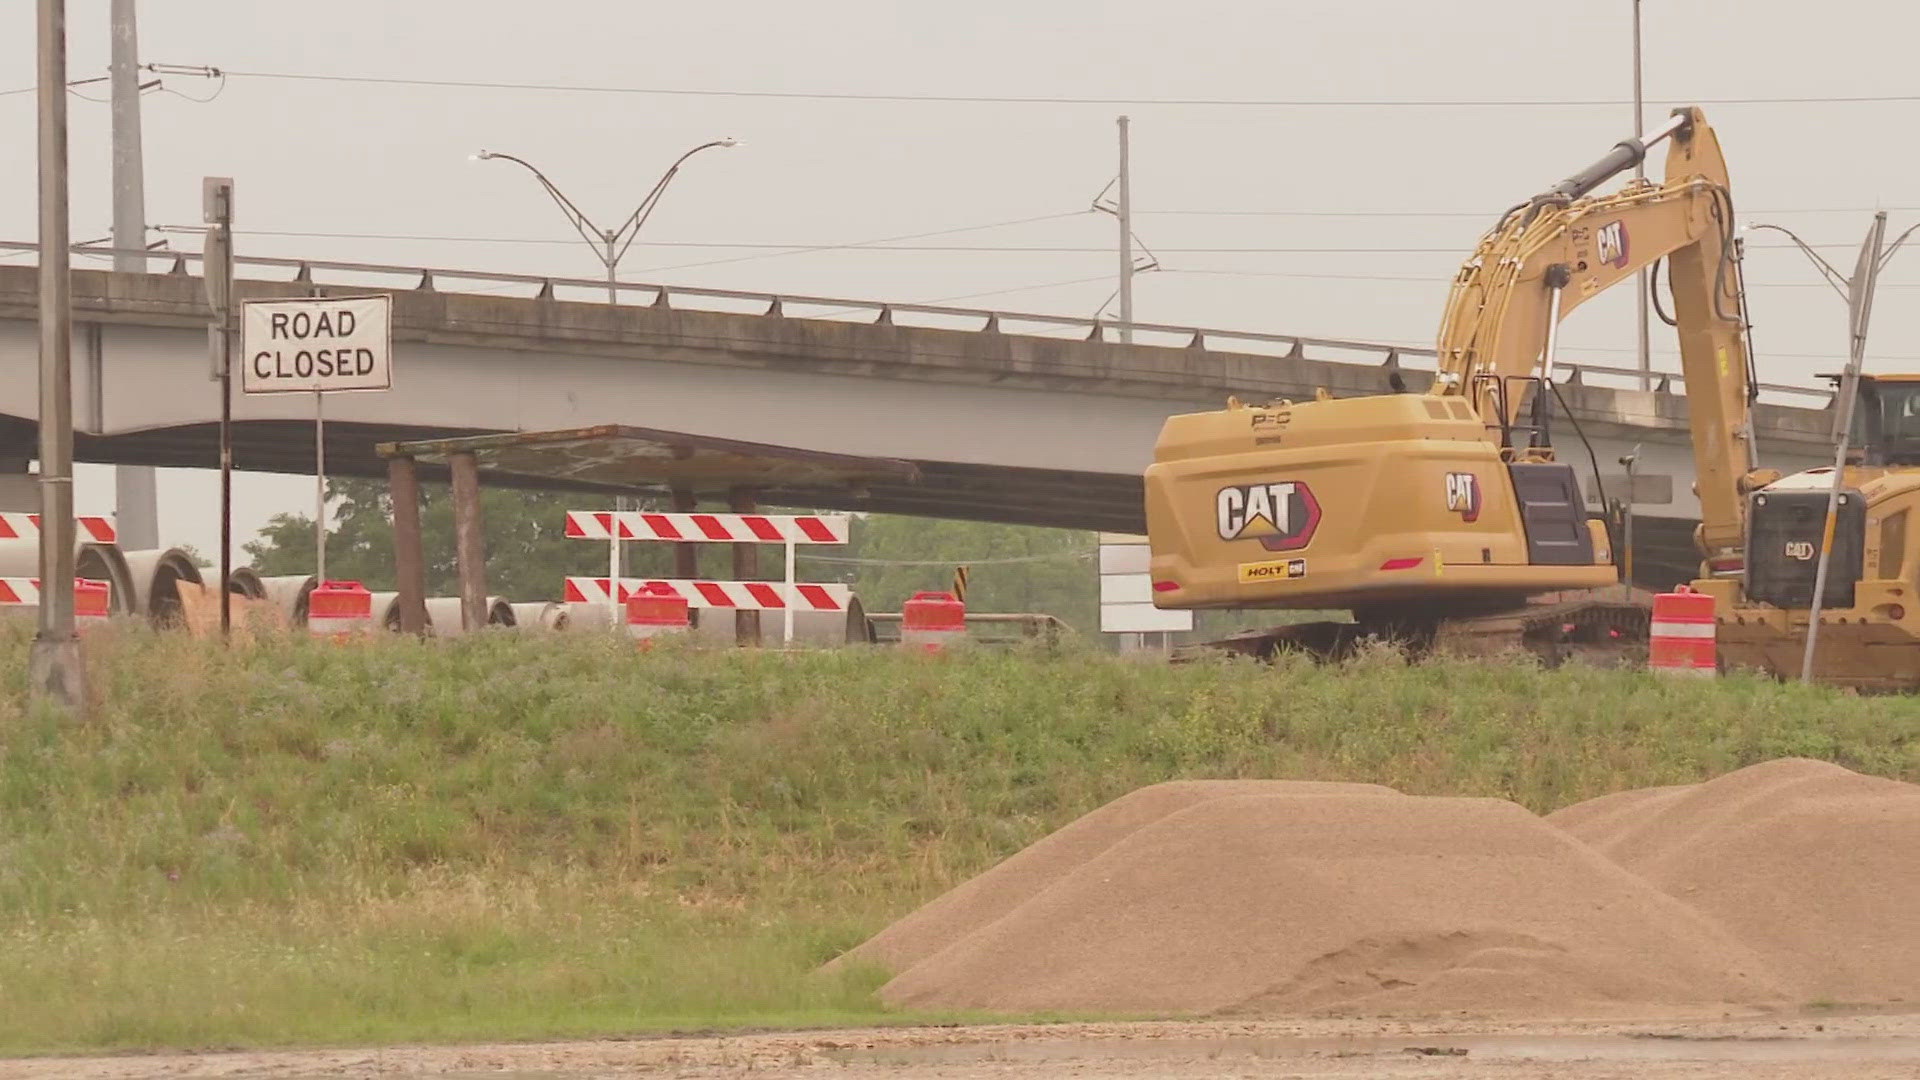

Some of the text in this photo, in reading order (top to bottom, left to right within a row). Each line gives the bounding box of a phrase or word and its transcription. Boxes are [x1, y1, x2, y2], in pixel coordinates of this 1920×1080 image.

[1597, 222, 1621, 265] CAT
[271, 311, 356, 340] ROAD
[254, 349, 374, 379] CLOSED
[1445, 473, 1473, 510] CAT
[1217, 483, 1295, 539] CAT
[1785, 541, 1807, 557] CAT
[1248, 566, 1284, 576] HOLT
